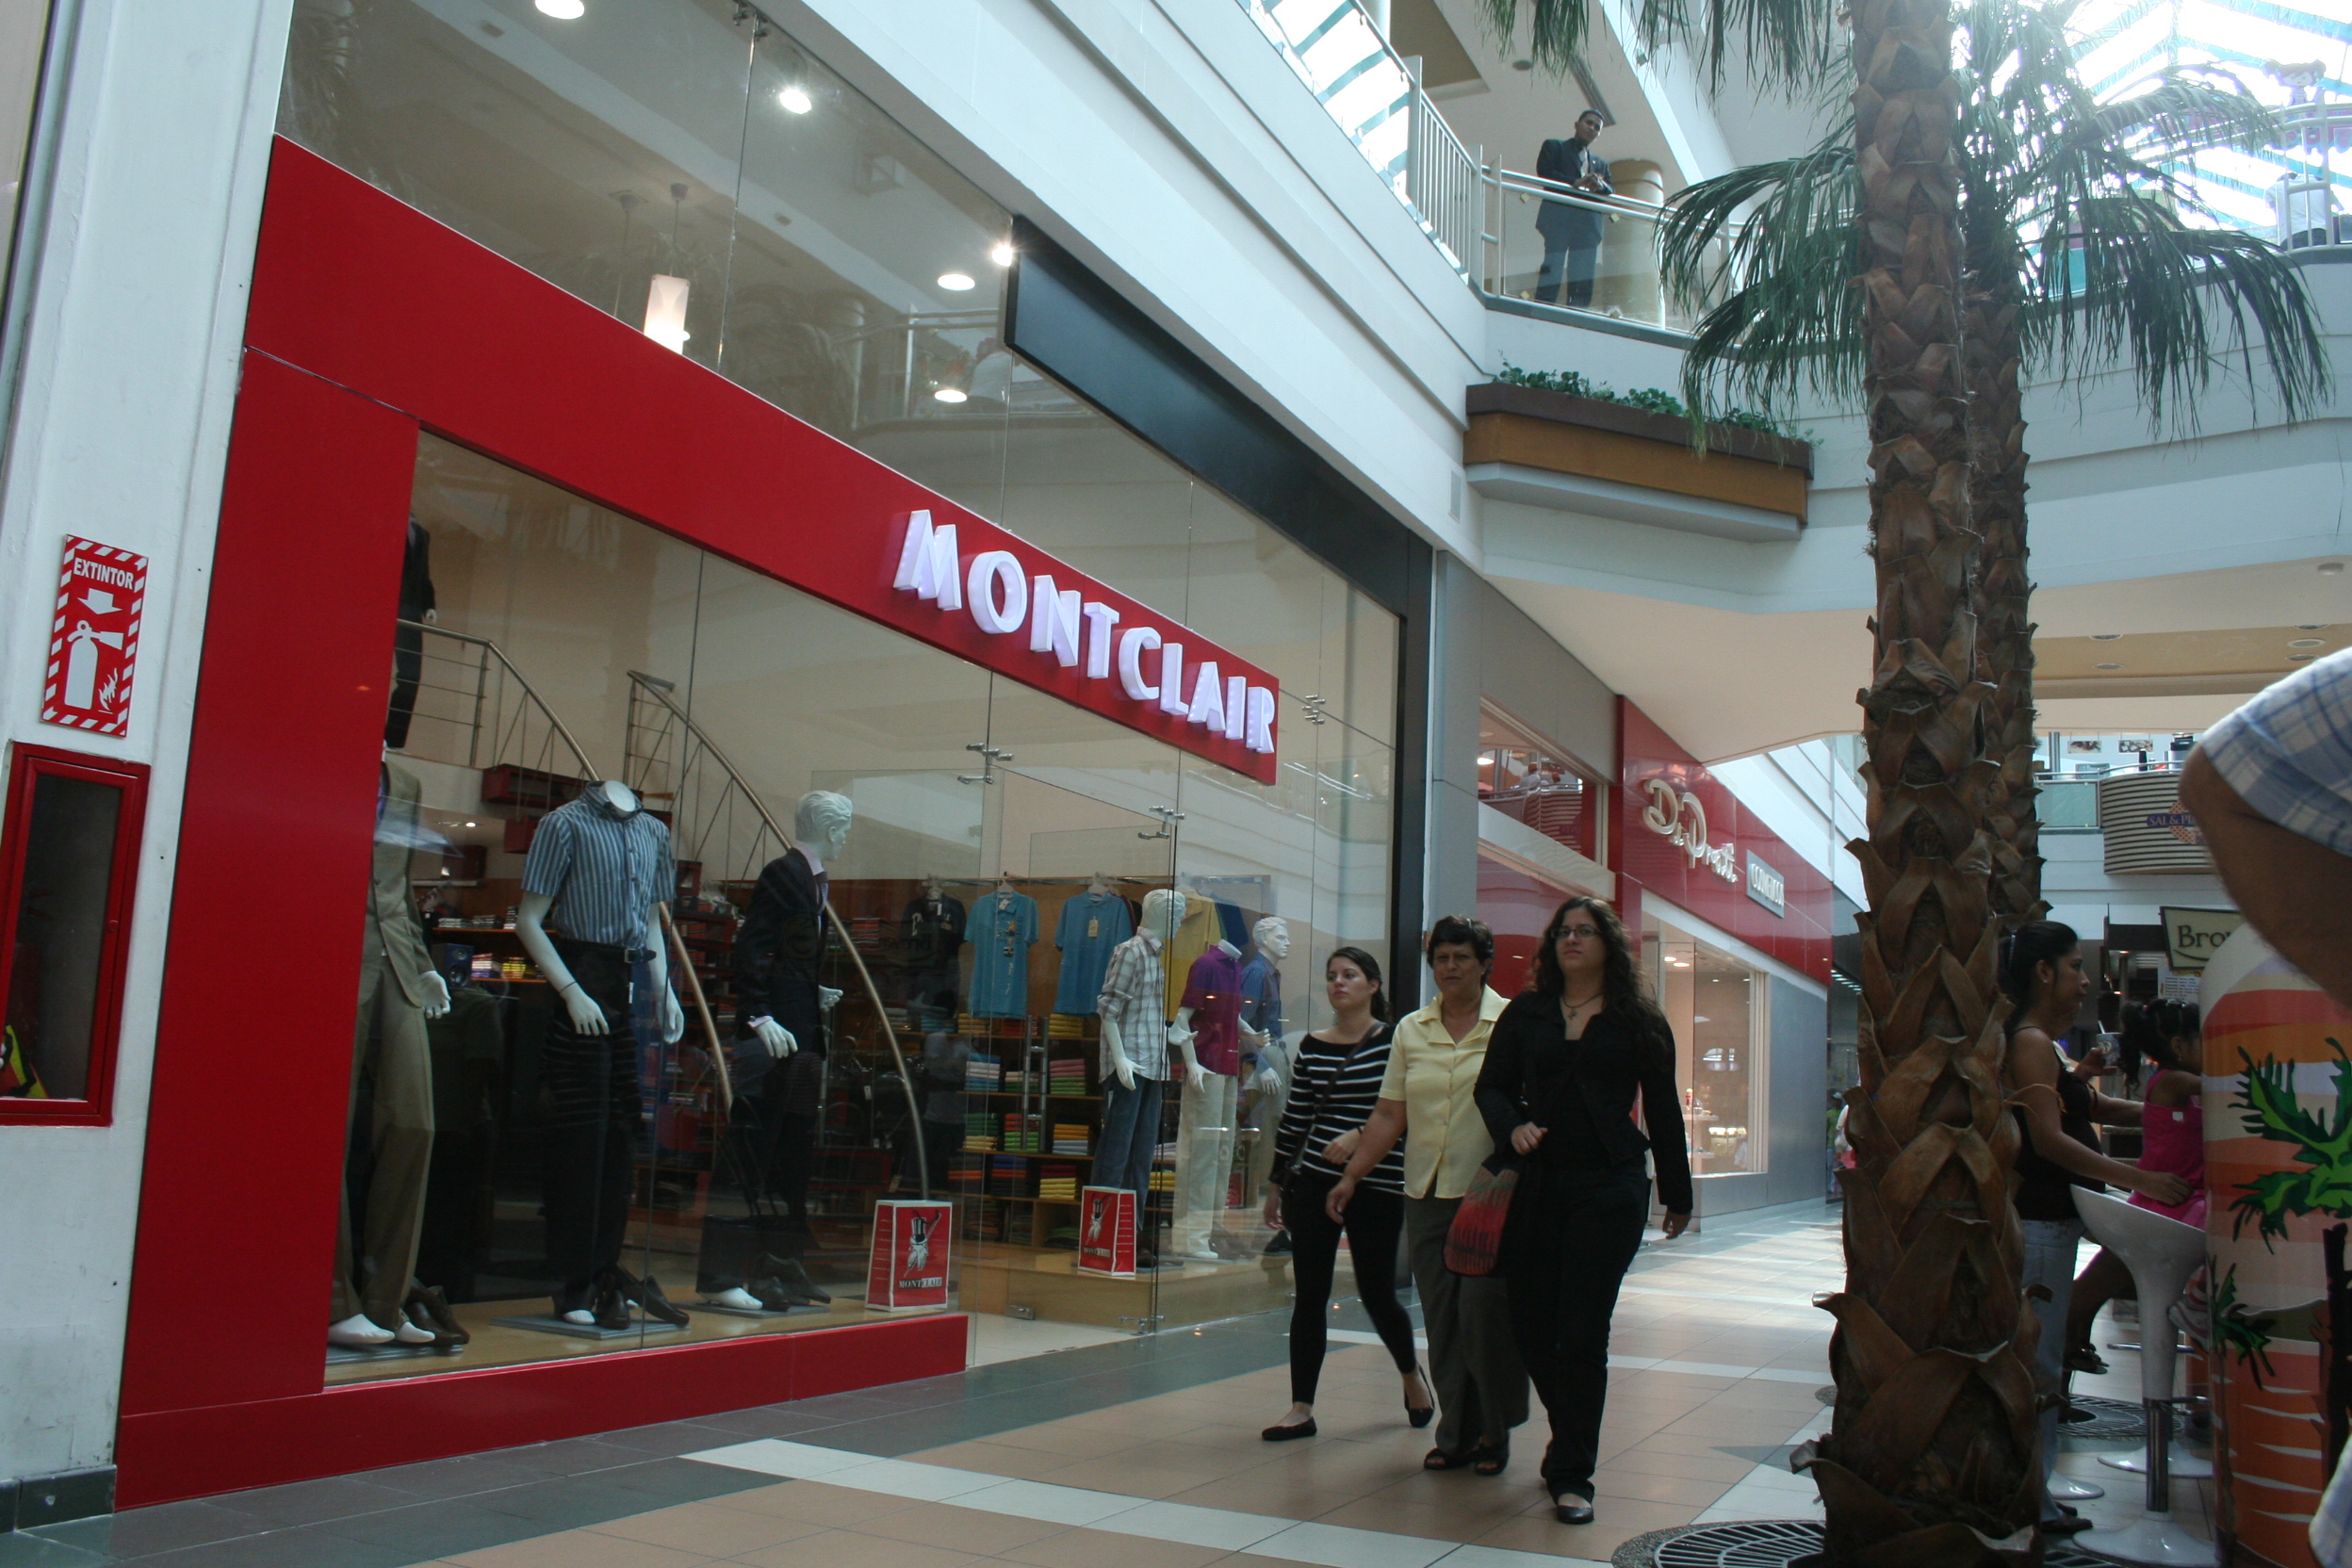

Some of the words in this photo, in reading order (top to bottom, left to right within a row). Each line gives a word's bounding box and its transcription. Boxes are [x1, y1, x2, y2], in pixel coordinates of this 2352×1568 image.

[73, 557, 134, 590] EXTINTOR
[893, 510, 1276, 753] MONTCLAIR
[2148, 815, 2168, 826] SAL
[2169, 815, 2180, 825] &
[898, 1277, 942, 1289] MONTCLAIR
